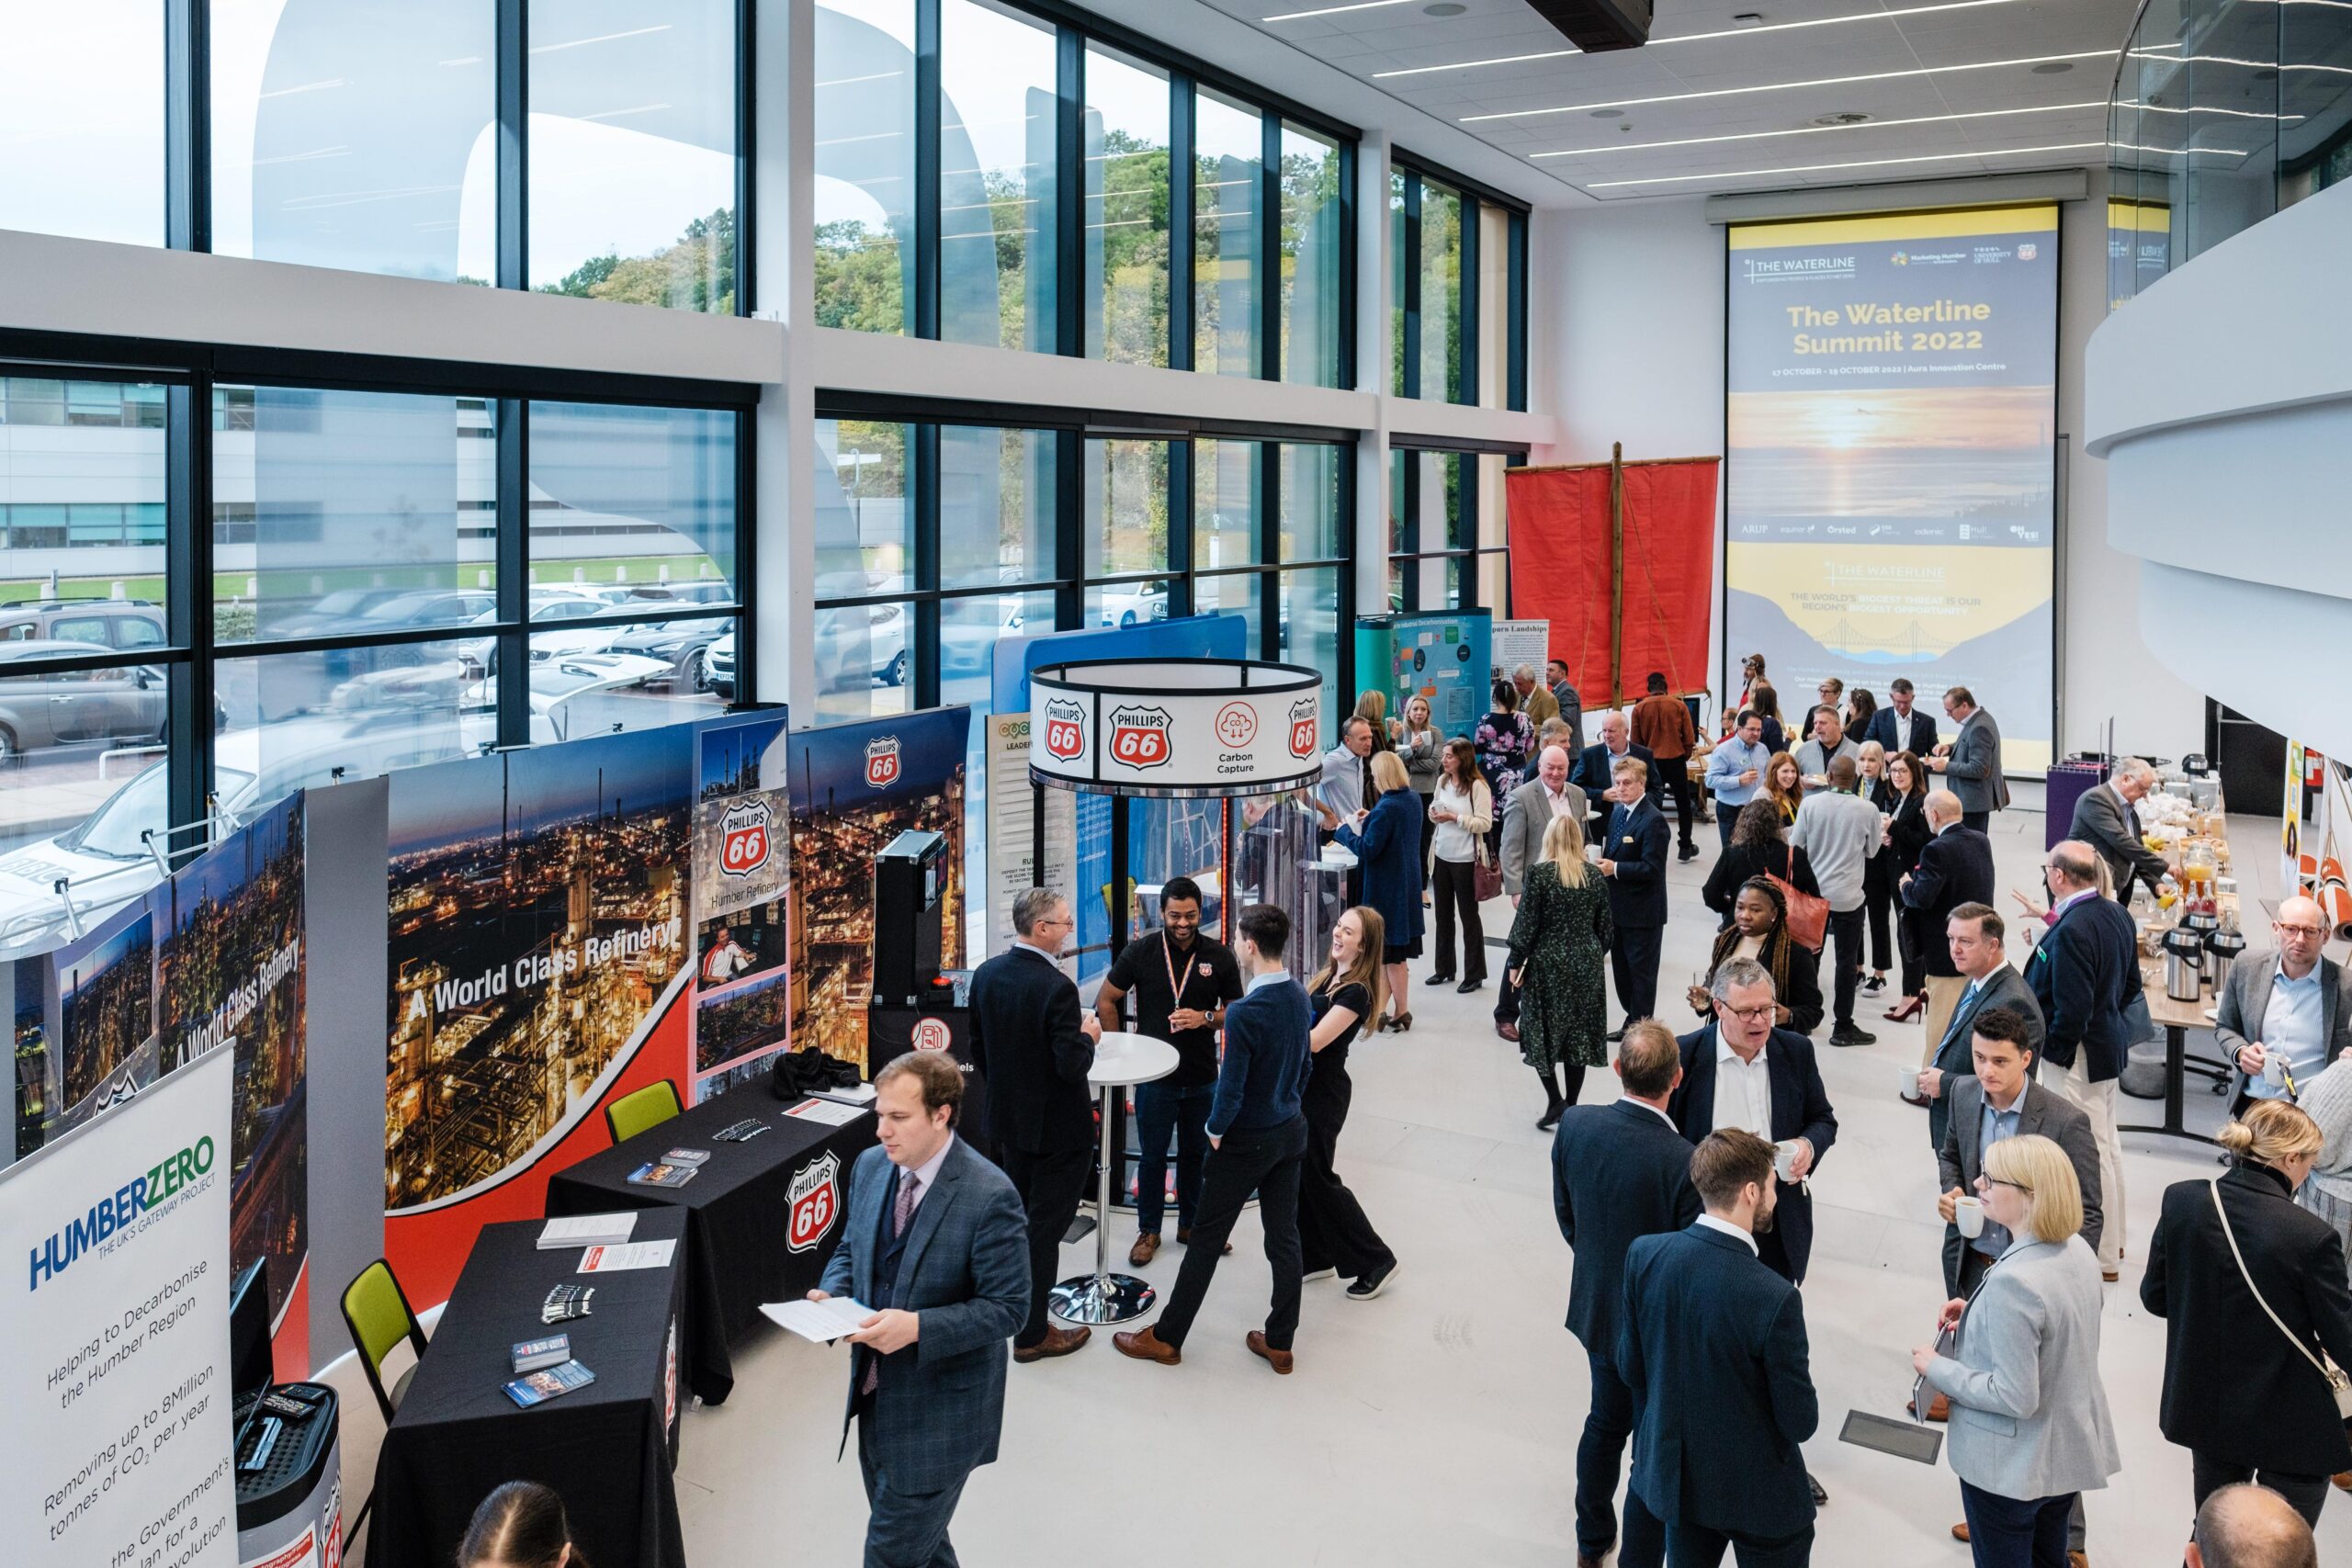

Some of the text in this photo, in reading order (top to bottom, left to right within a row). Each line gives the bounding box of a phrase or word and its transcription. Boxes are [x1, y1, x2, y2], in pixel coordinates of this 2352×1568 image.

[1756, 256, 1856, 272] THE WATERLINE
[1786, 299, 1992, 328] The Waterline
[1792, 331, 1984, 355] Summit 2022
[1782, 367, 1822, 377] OCTOBER
[1839, 366, 1881, 375] OCTOBER
[1882, 366, 1902, 374] 2022
[1907, 365, 1928, 373] Aura
[1929, 363, 1975, 372] Innovation
[1742, 525, 1769, 534] ARUP
[1971, 525, 1987, 534] Hull
[1837, 565, 1947, 579] THE WATERLINE
[1791, 592, 1982, 607] THE WORLD'S BIGGEST THREAT IS OUR
[1802, 603, 1969, 616] REGION'S BIGGEST OPPORTUNITY
[1418, 618, 1459, 626] Decarbonisation
[1510, 625, 1548, 634] Landships
[1049, 706, 1080, 722] PHILLIPS
[1117, 714, 1164, 728] PHILLIPS
[1294, 705, 1316, 721] PHILLIPS
[870, 742, 896, 756] PHILLIPS
[1050, 724, 1077, 750] 66
[1120, 732, 1159, 757] 66
[1295, 723, 1314, 750] 66
[872, 757, 894, 779] 66
[1216, 763, 1254, 774] Capture
[1218, 753, 1253, 762] Carbon
[728, 811, 764, 831] PHILLIPS
[729, 831, 762, 864] 66
[711, 880, 779, 909] Humber Refinery
[408, 917, 682, 1022] A World Class Refinery
[176, 936, 300, 1069] A World Class Refinery
[794, 1163, 831, 1201] PHILLIPS
[29, 1135, 215, 1292] HUMBERZERO
[97, 1171, 216, 1260] THE UK'S GATEWAY PROJECT
[796, 1189, 829, 1238] 66
[48, 1260, 208, 1392] Helping to Decarbonise
[61, 1296, 197, 1409] the Humber Region
[44, 1365, 214, 1517] Removing up to 8Million
[50, 1488, 99, 1541] tonnes
[102, 1465, 119, 1492] of
[153, 1421, 177, 1453] per
[181, 1394, 210, 1431] year
[111, 1456, 230, 1568] the Government's
[140, 1516, 198, 1568] lan for a
[168, 1516, 227, 1568] volution
